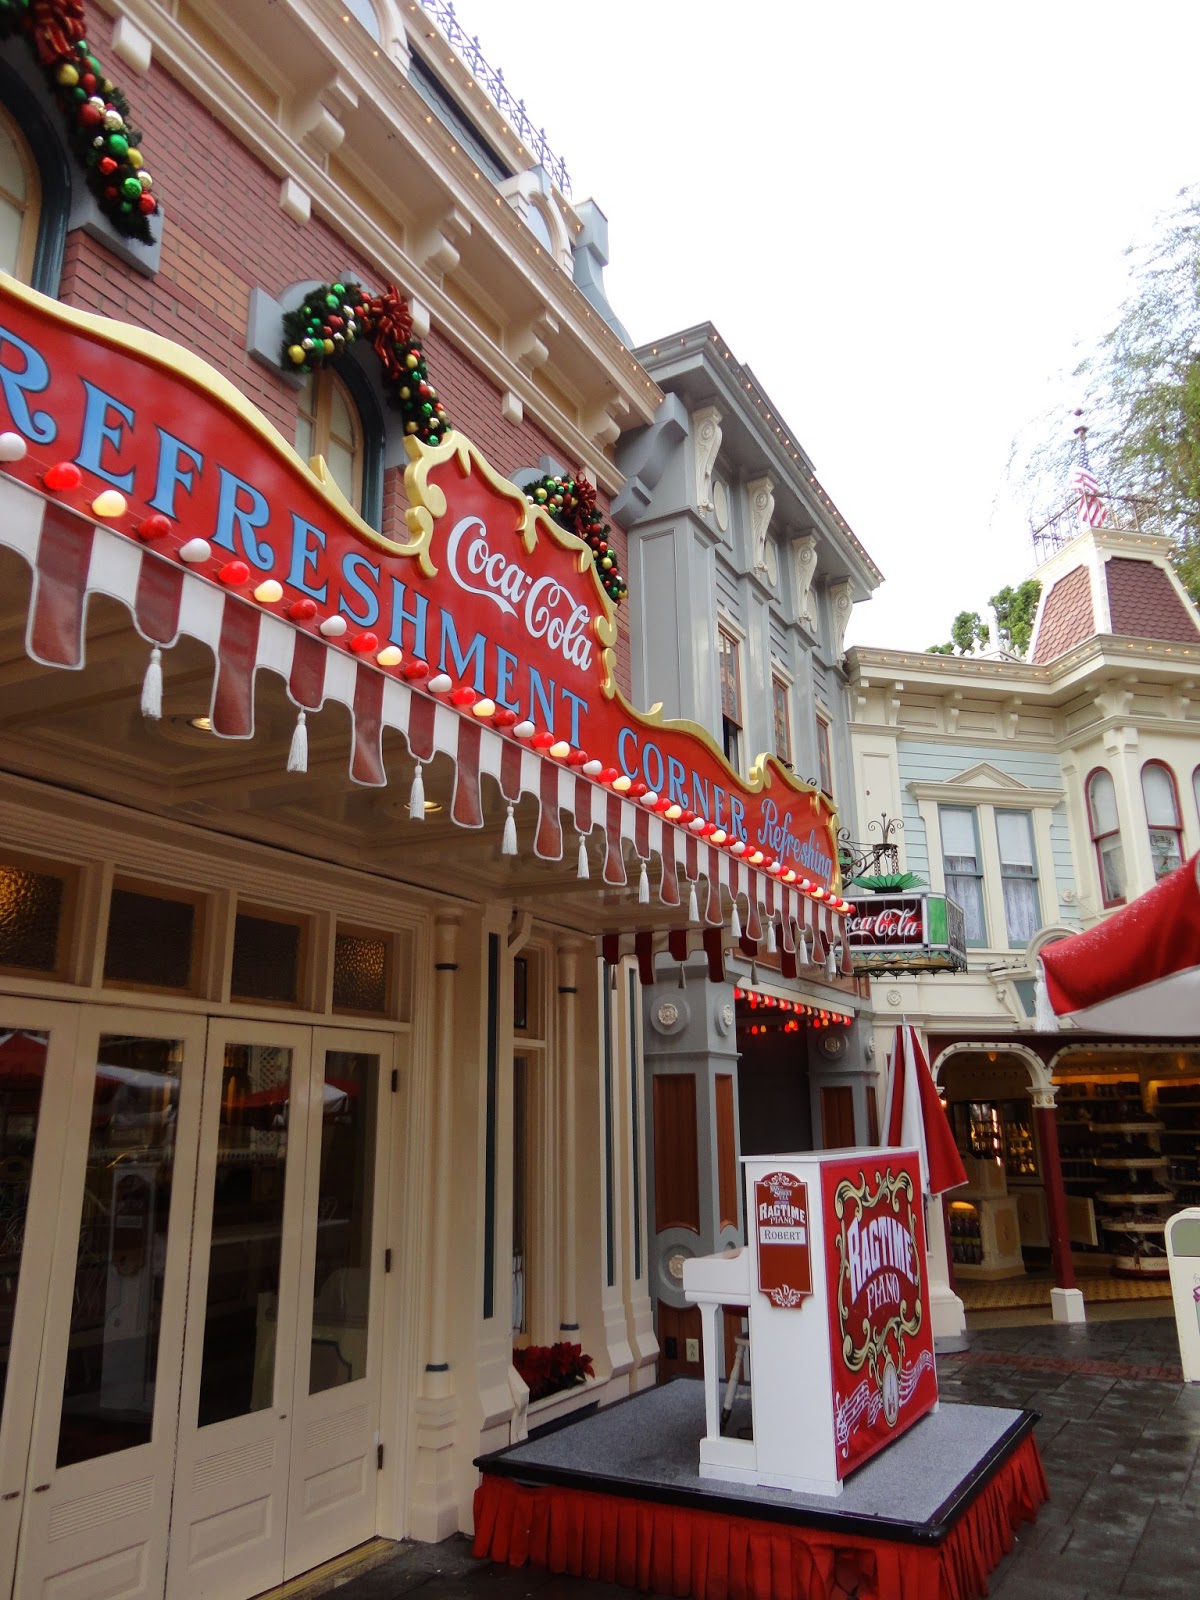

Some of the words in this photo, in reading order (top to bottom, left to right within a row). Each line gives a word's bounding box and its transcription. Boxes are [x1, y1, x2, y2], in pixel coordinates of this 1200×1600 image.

[0, 326, 589, 750] REFRESHMENT
[617, 727, 748, 843] CORNER
[447, 516, 593, 672] Coca-Cola
[757, 798, 832, 893] Refreshing
[759, 1203, 806, 1224] RAGTIME
[764, 1230, 801, 1241] ROBERT
[770, 1216, 795, 1225] PIANO
[847, 1216, 915, 1305] RAGTIME
[866, 1273, 900, 1318] PIANO
